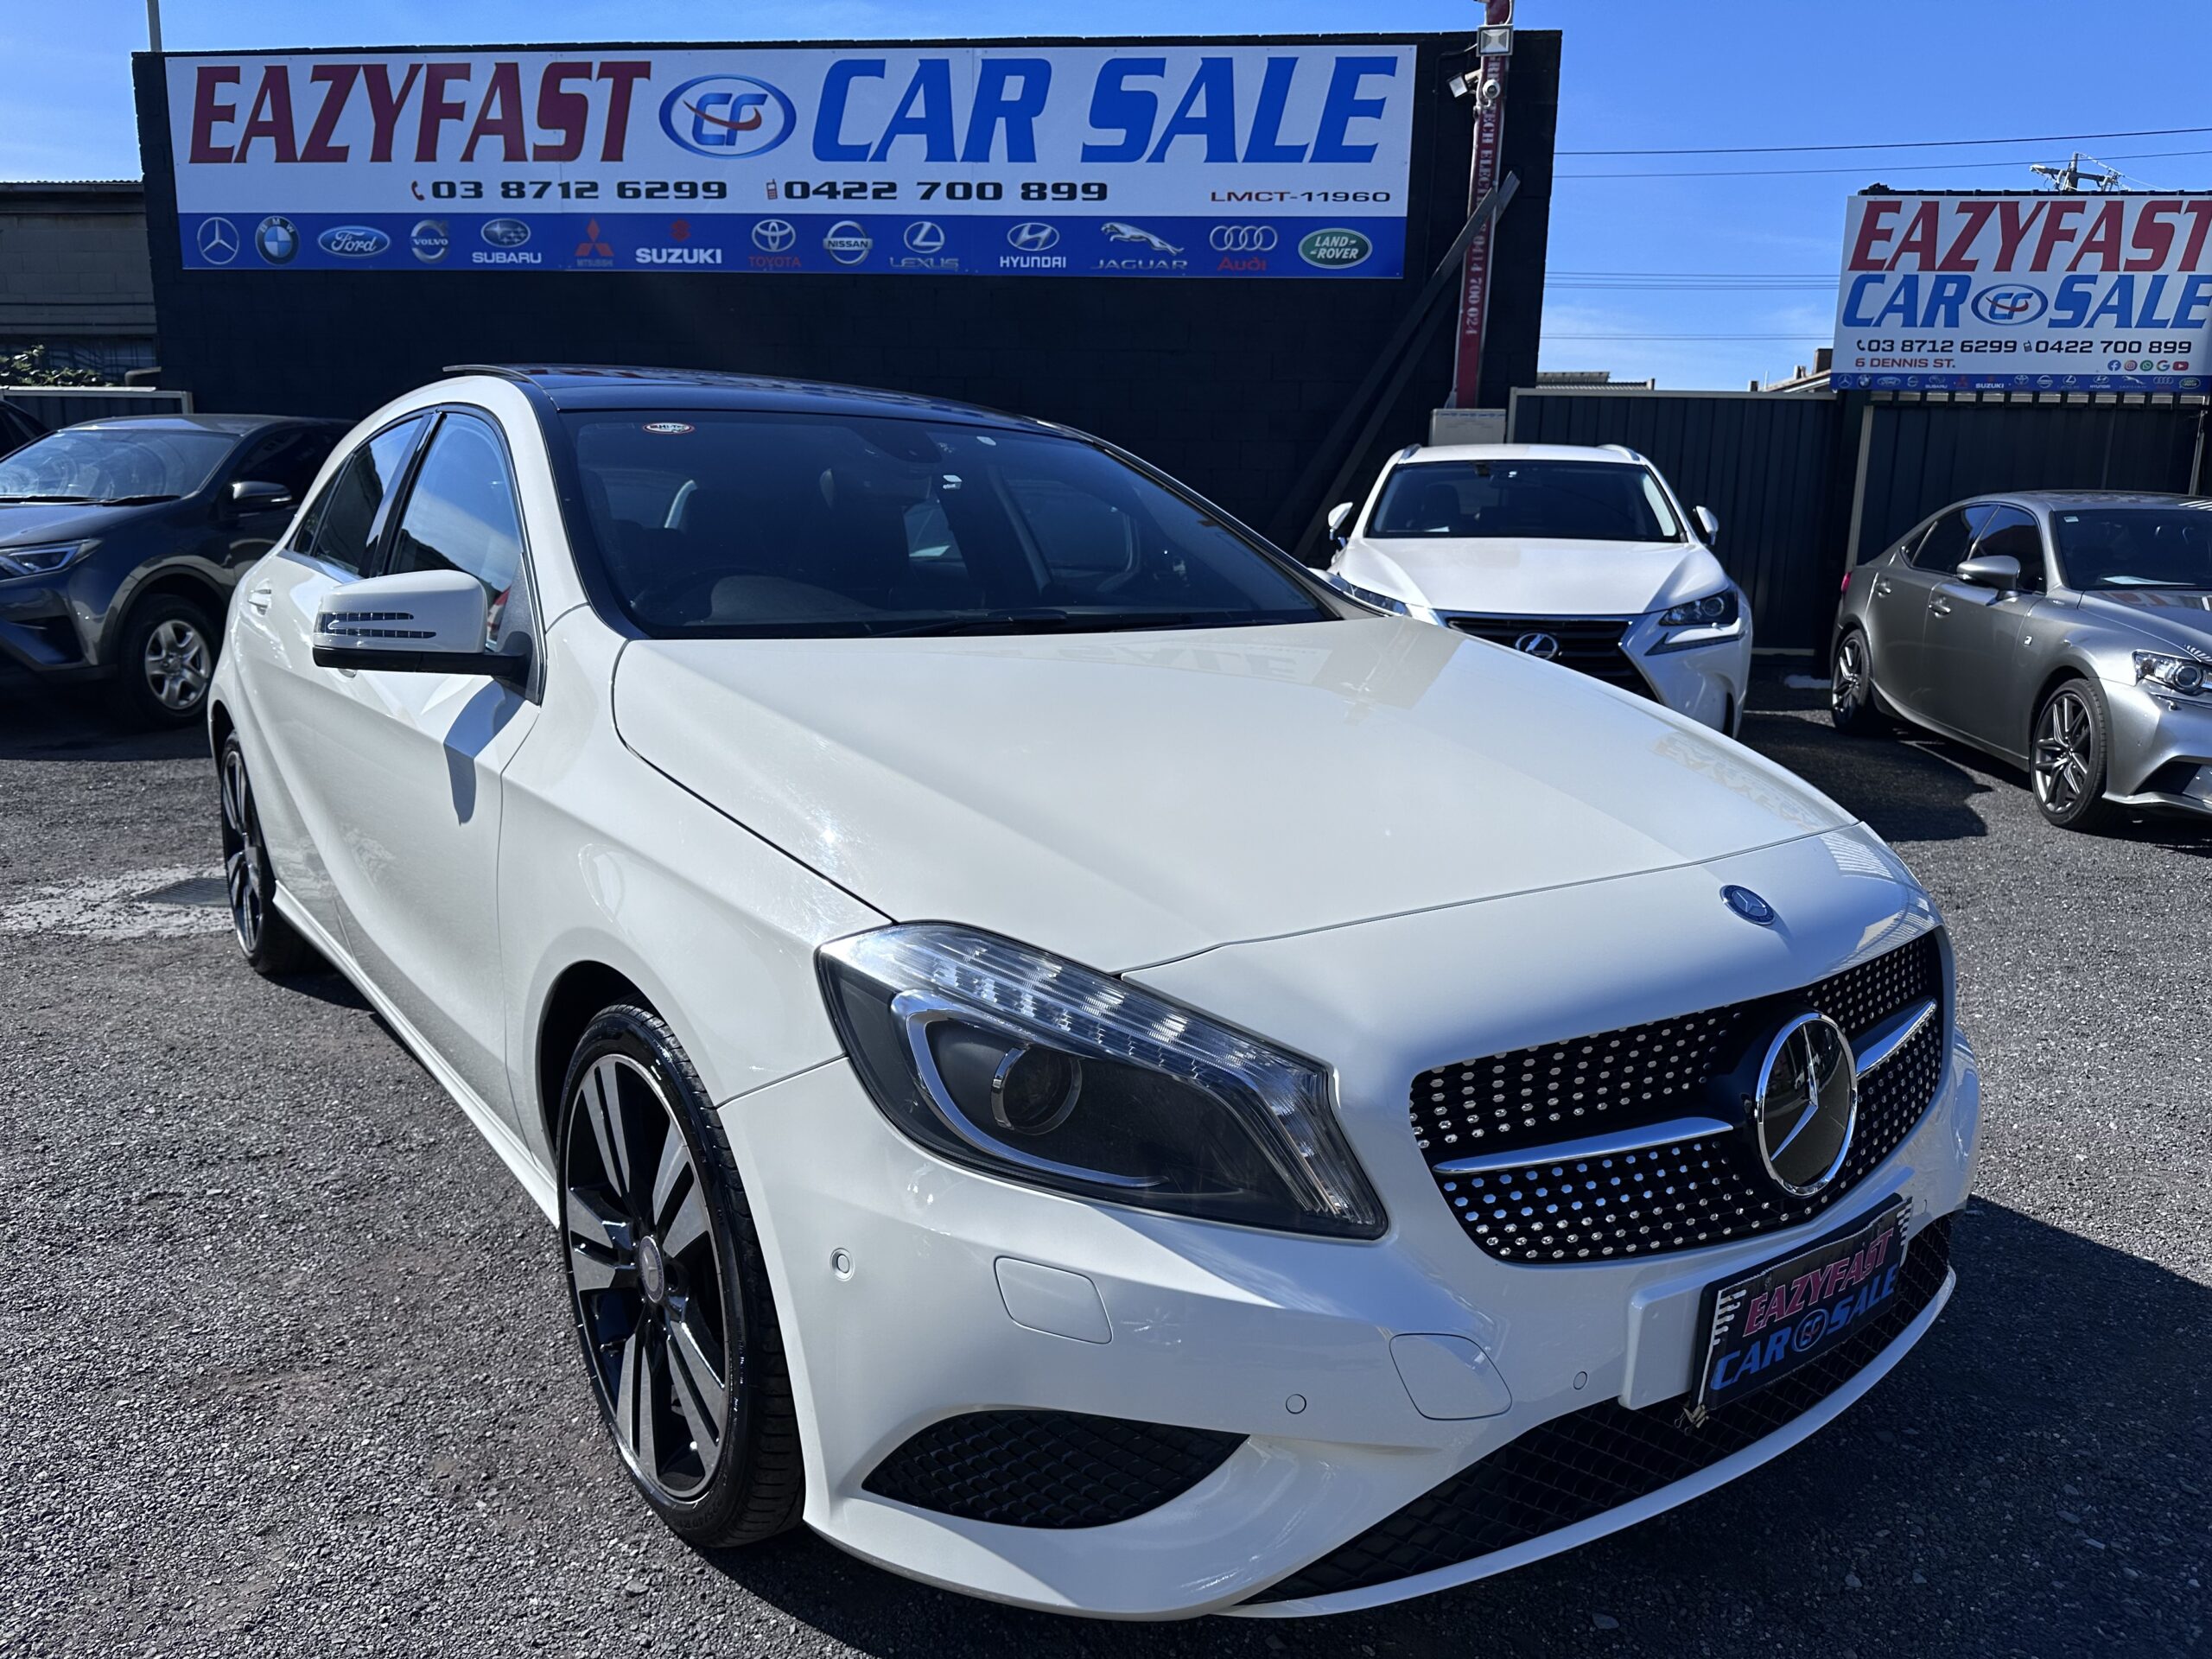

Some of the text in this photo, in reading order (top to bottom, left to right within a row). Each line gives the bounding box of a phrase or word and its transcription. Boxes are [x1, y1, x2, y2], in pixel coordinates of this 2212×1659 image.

[188, 61, 652, 163] EAZYFAST
[812, 58, 1052, 163] CAR
[1081, 56, 1397, 163] SALE
[432, 181, 728, 200] 03 8712 6299
[784, 181, 1108, 201] 0422 700 899
[1211, 192, 1390, 202] LMCT-11960
[331, 231, 377, 252] Ford
[413, 238, 448, 246] VOLVO
[1847, 200, 2212, 272] EAZYFAST
[827, 240, 869, 249] NISSAN
[472, 251, 542, 264] SUBARU
[635, 248, 721, 264] SUZUKI
[748, 257, 801, 268] TOYOTA
[1000, 256, 1066, 268] HYUNDAI
[889, 257, 959, 270] LEXUS
[1090, 259, 1187, 270] JAGUAR
[1217, 257, 1267, 271] Audi
[1842, 274, 1972, 328] CAR
[2048, 274, 2212, 328] SALE
[1867, 340, 2018, 353] 03 8712 6299
[2035, 340, 2192, 354] 0422 700 899
[1855, 358, 1955, 368] 6 DENNIS ST.
[1742, 1228, 1893, 1338] EAZYFAST
[1710, 1326, 1791, 1391] CAR
[1827, 1264, 1899, 1336] SALE
